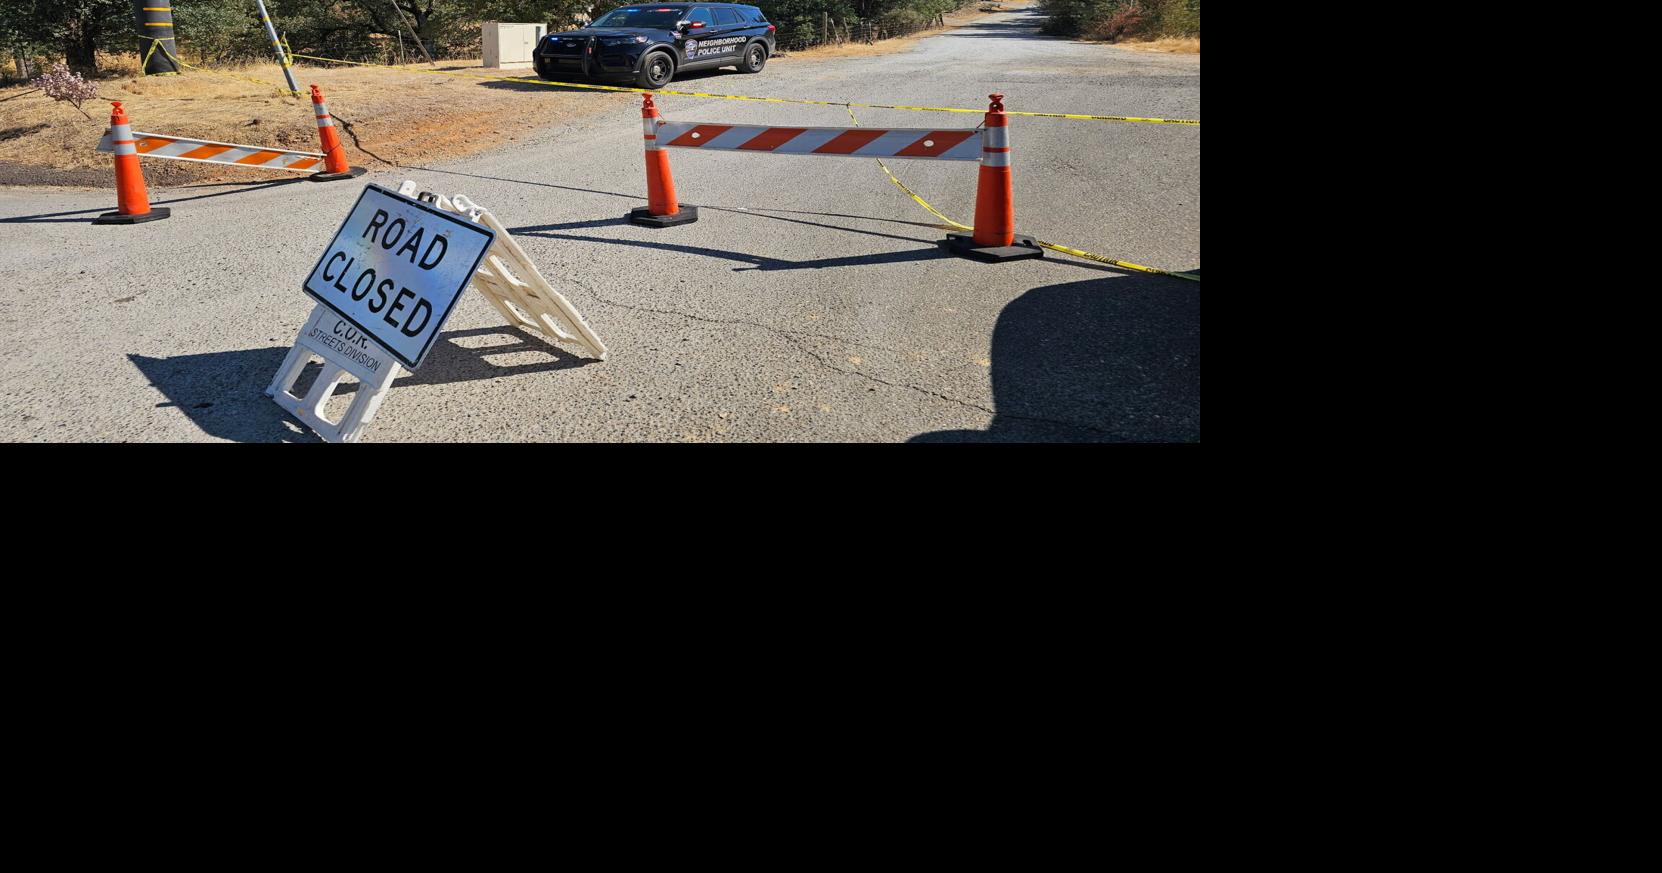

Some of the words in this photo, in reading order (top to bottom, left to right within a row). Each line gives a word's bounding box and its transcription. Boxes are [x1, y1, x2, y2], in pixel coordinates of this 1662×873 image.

[698, 36, 747, 47] NEIGHBORHOOD
[698, 46, 721, 56] POLICE
[721, 45, 737, 53] UNIT
[362, 208, 448, 271] ROAD
[322, 251, 433, 338] CLOSED
[309, 327, 346, 352] STREETS
[344, 345, 382, 372] DIVISION
